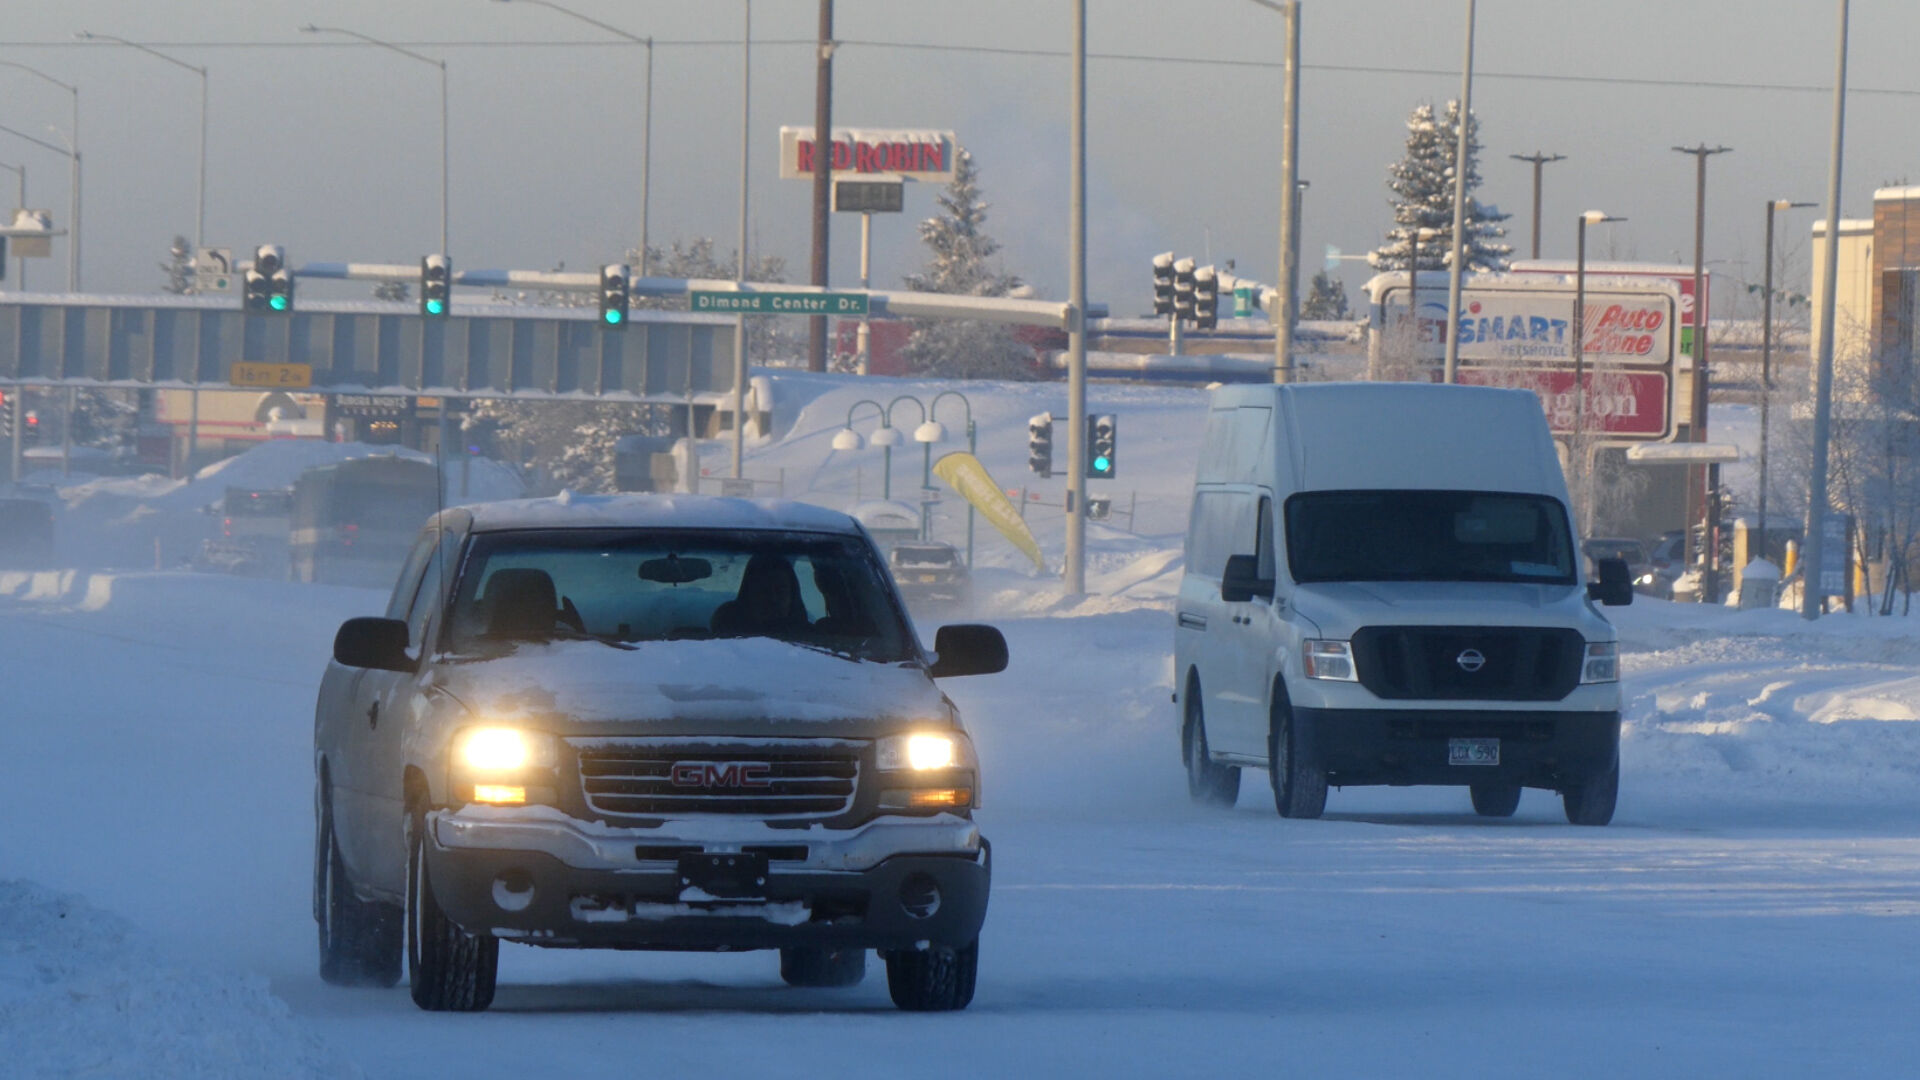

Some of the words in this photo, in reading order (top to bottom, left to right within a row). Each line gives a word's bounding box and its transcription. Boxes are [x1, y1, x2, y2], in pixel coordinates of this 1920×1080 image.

[798, 141, 851, 172] RD
[856, 141, 943, 173] ROBIN
[699, 296, 761, 309] Dimond
[772, 297, 827, 310] Center
[838, 298, 861, 311] Dr.
[1598, 304, 1664, 332] Auto
[1501, 345, 1567, 357] PETSHOTEL
[1584, 328, 1653, 355] Zone
[672, 764, 770, 787] GMC
